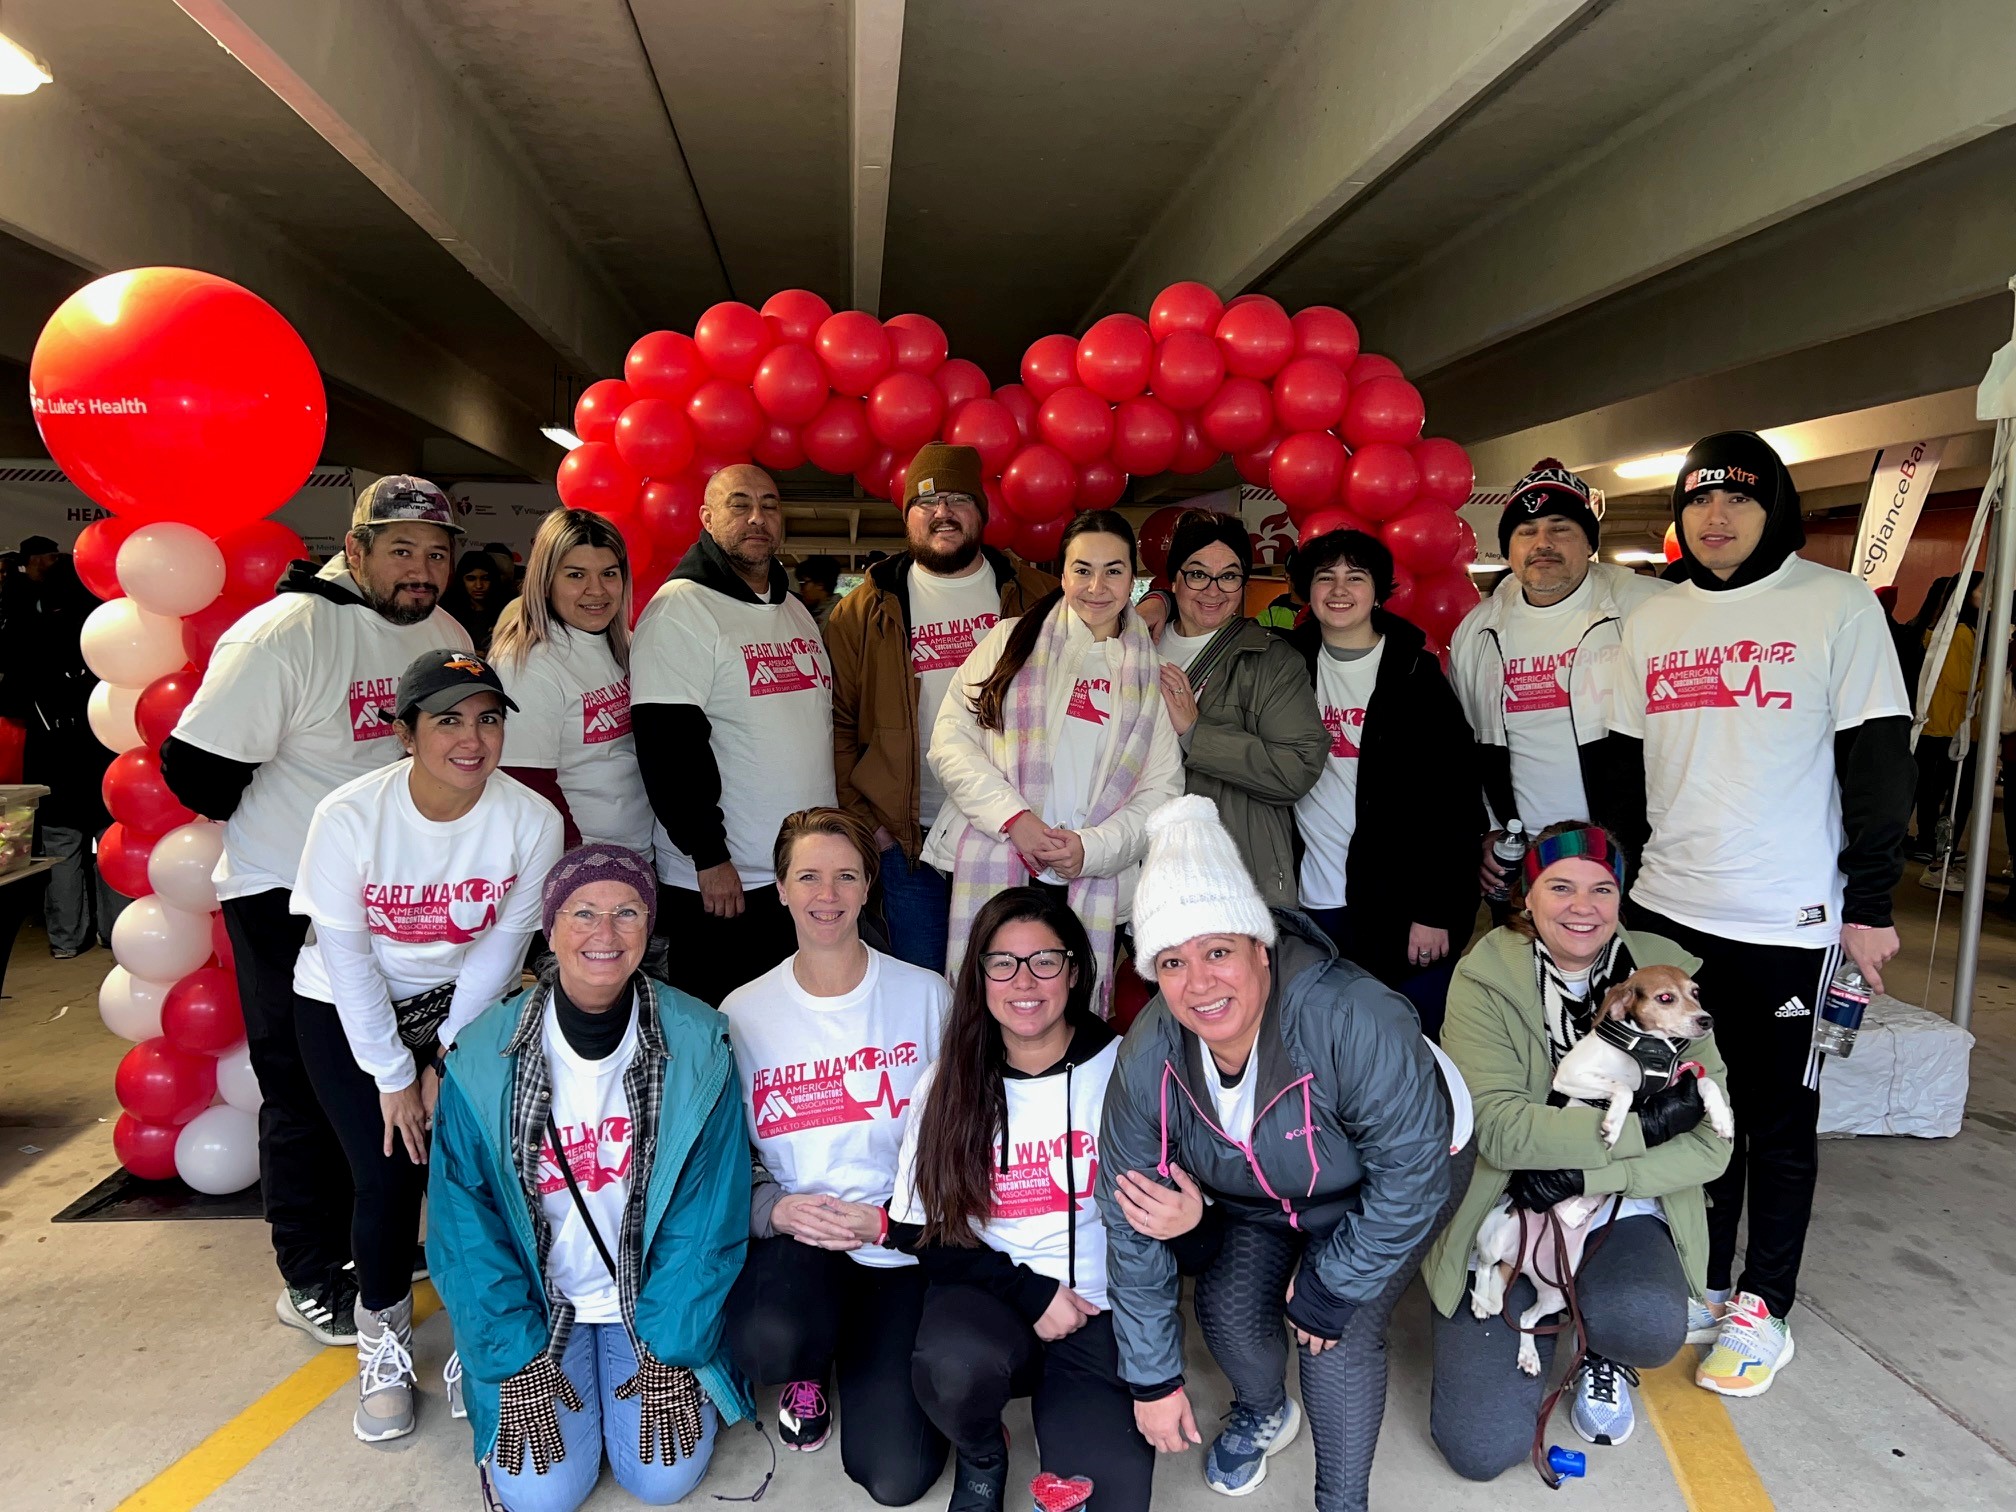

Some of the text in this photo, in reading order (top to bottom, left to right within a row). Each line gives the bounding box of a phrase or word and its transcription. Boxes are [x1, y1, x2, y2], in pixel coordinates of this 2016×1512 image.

[48, 398, 86, 414] Luke's
[89, 397, 147, 414] Health
[1697, 468, 1725, 483] Pro
[1725, 466, 1759, 485] Xtra
[910, 621, 943, 639] EART
[948, 615, 989, 635] WALK
[930, 634, 972, 645] AMERICAN
[741, 643, 774, 660] HEART
[1695, 645, 1744, 667] WALK
[1749, 644, 1797, 665] 2022
[768, 659, 795, 667] AMERICAN
[1509, 673, 1555, 685] AMERICAN
[1668, 667, 1719, 680] AMERICAN
[350, 678, 393, 700] HEART
[580, 686, 610, 709] HEART
[364, 883, 415, 904] EART
[422, 882, 474, 903] WALK
[388, 905, 448, 916] AMERICAN
[393, 915, 448, 924] SUBCONTRACTORS
[397, 923, 448, 931] ASSOCIATION
[1775, 1008, 1811, 1018] adidas
[753, 1048, 918, 1092] HEART WALK 2022
[785, 1079, 843, 1097] AMERICAN
[790, 1088, 843, 1105] SUBCONTRACTORS
[796, 1097, 844, 1111] ASSOCIATION
[796, 1105, 845, 1117] HOUSTON CHAPTER
[760, 1130, 769, 1138] WE
[769, 1125, 789, 1136] WALK
[790, 1122, 800, 1130] TO
[801, 1118, 821, 1128] SAVE
[990, 1167, 1049, 1182] MERICAN
[995, 1178, 1050, 1192] SUBCONTRACTORS
[1002, 1187, 1051, 1199] ASSOCIATION
[1008, 1207, 1028, 1217] SAVE
